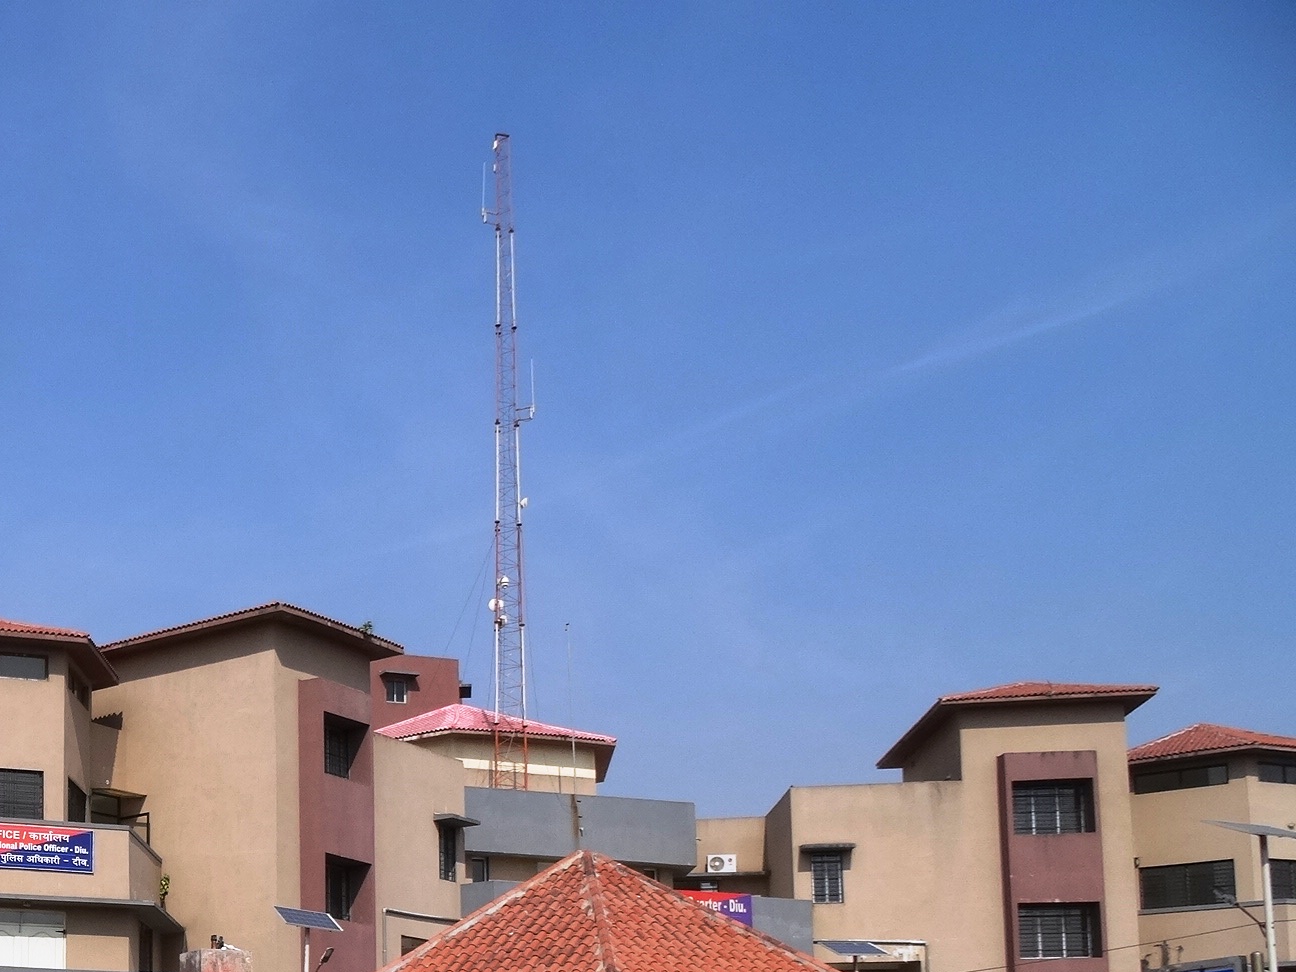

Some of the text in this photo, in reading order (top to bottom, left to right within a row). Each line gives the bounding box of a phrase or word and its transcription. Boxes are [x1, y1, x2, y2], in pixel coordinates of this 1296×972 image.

[28, 830, 71, 843] कार्यालय
[19, 842, 42, 852] Police
[43, 844, 69, 853] Officer
[74, 846, 89, 854] Diu.
[1, 853, 24, 863] पुलिस
[26, 853, 61, 865] अधिकारी
[729, 899, 747, 913] Diu.
